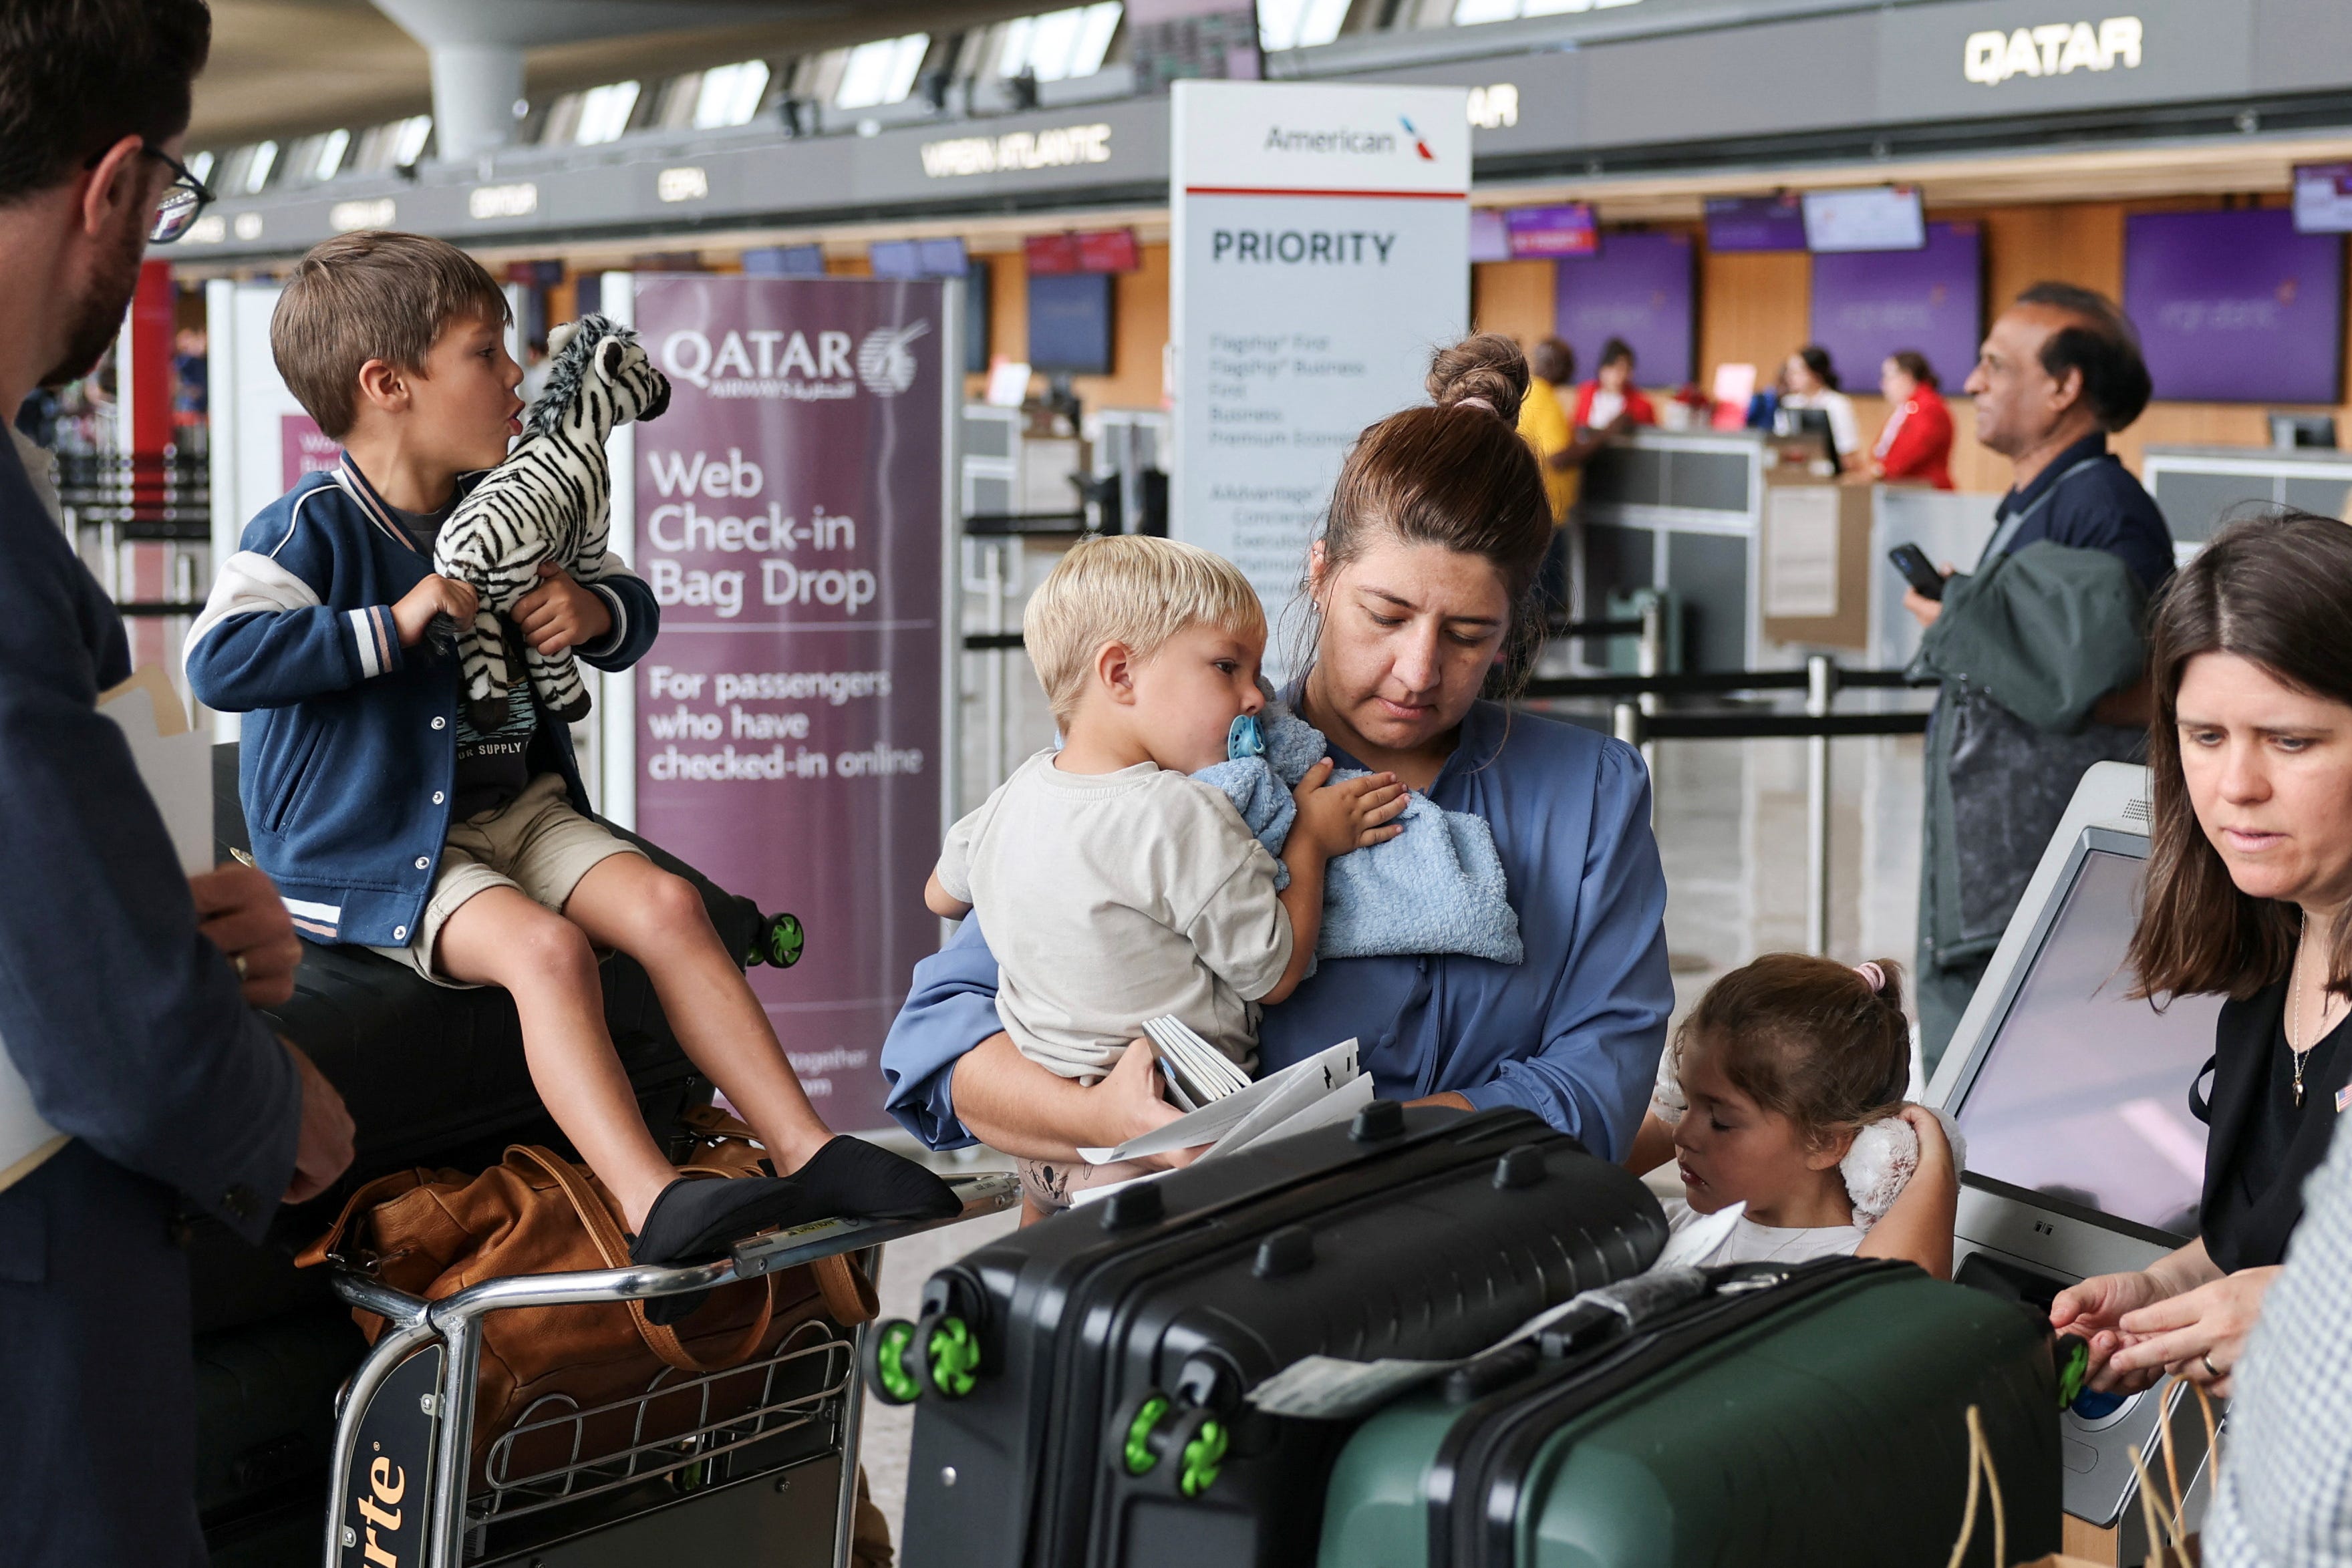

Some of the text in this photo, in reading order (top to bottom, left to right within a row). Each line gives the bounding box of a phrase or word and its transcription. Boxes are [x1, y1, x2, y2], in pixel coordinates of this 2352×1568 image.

[1964, 16, 2142, 86] QATAR
[1264, 124, 1396, 154] American
[1212, 230, 1396, 264] PRIORITY
[662, 330, 853, 389] QATAR
[647, 447, 764, 498] Web
[648, 501, 856, 553] Check-in
[651, 559, 877, 618] Bag Drop
[649, 666, 891, 706] For passengers
[648, 704, 809, 740] who have
[478, 742, 521, 755] SUPPLY
[648, 742, 923, 780] checked-in online
[357, 1456, 406, 1568] rte
